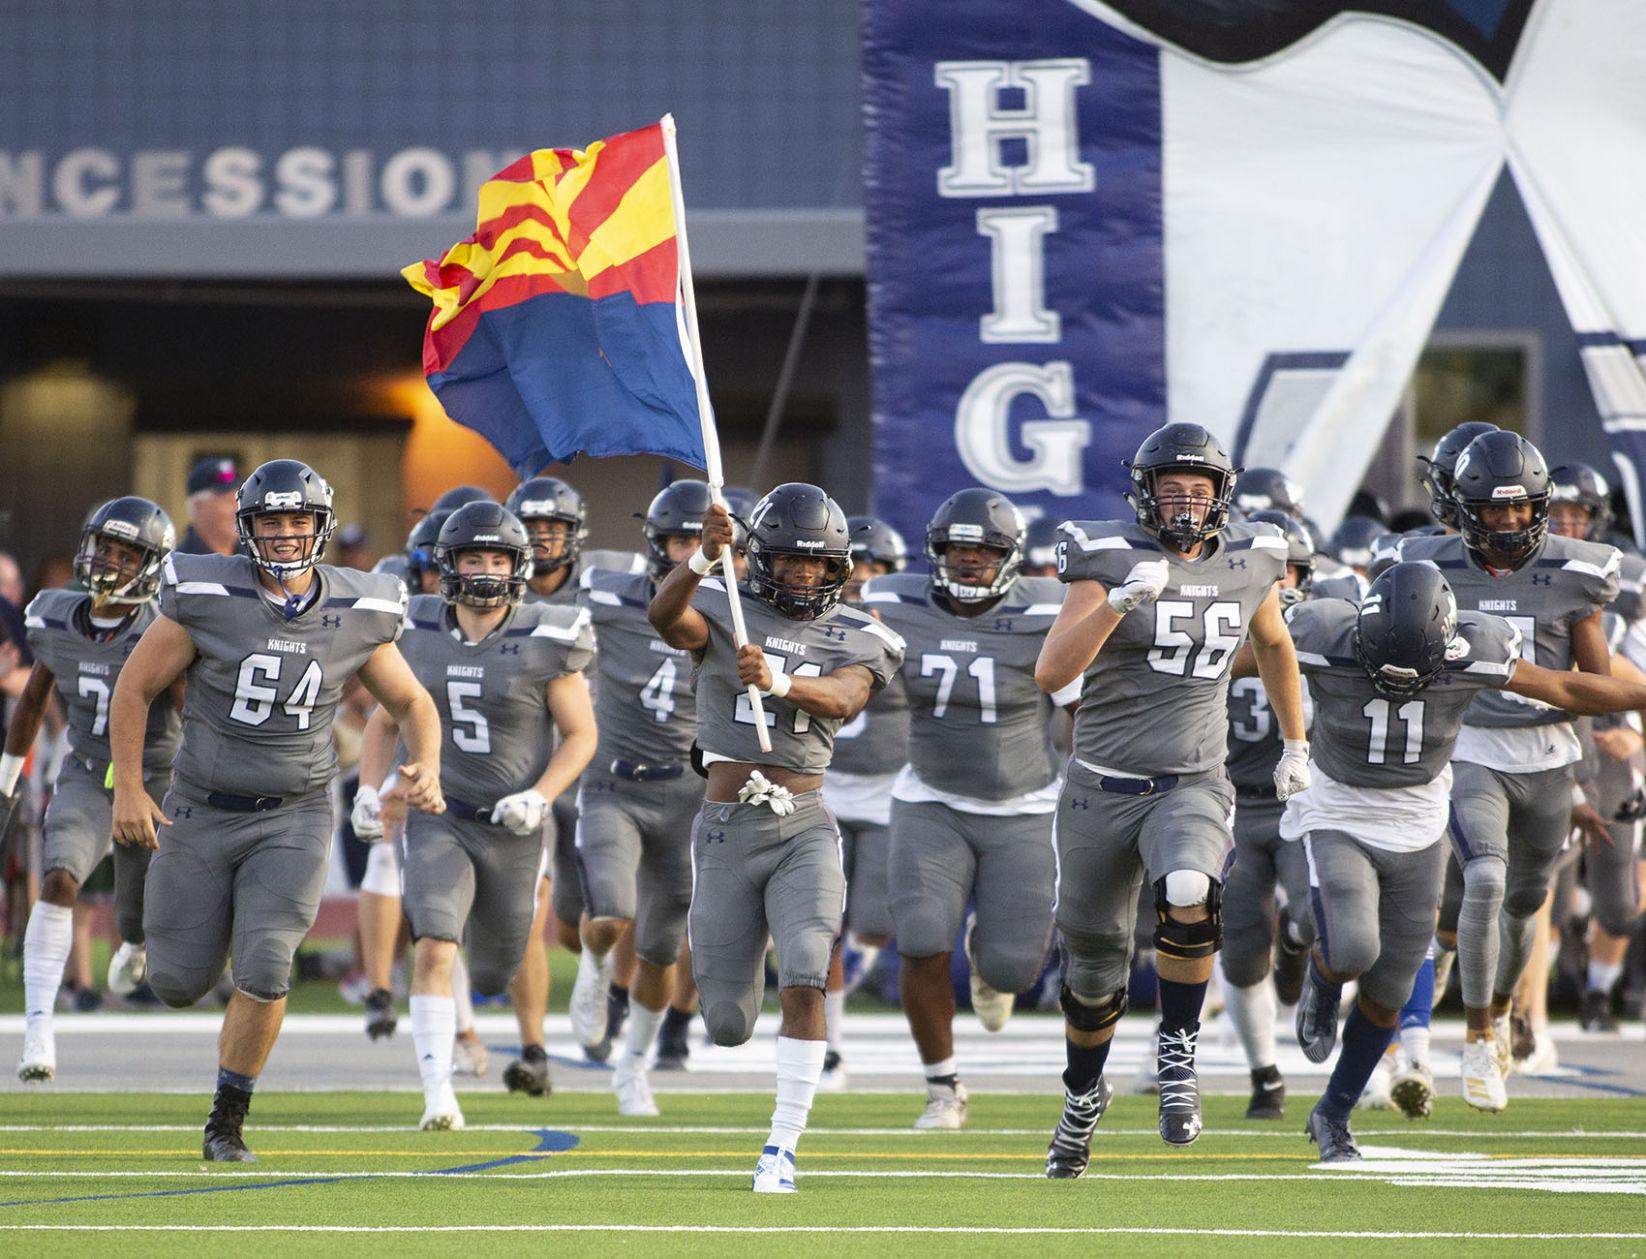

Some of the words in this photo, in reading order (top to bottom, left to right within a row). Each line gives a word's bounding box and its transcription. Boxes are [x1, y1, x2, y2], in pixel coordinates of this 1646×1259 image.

[934, 57, 1096, 522] HIG
[796, 540, 825, 549] Riddell
[1056, 541, 1068, 575] 6
[1179, 584, 1218, 598] KNIGHTS
[1478, 599, 1517, 612] KNIGHTS
[267, 638, 307, 654] KNIGHTS
[765, 636, 806, 656] KNIGHTS
[939, 639, 978, 653] KNIGHTS
[1147, 600, 1242, 680] 56
[229, 652, 323, 730] 64
[446, 665, 484, 678] KNIGHTS
[639, 656, 677, 723] 4
[920, 654, 998, 724] 71
[77, 676, 111, 736] 7
[446, 681, 491, 754] 5
[1363, 699, 1427, 765] 11
